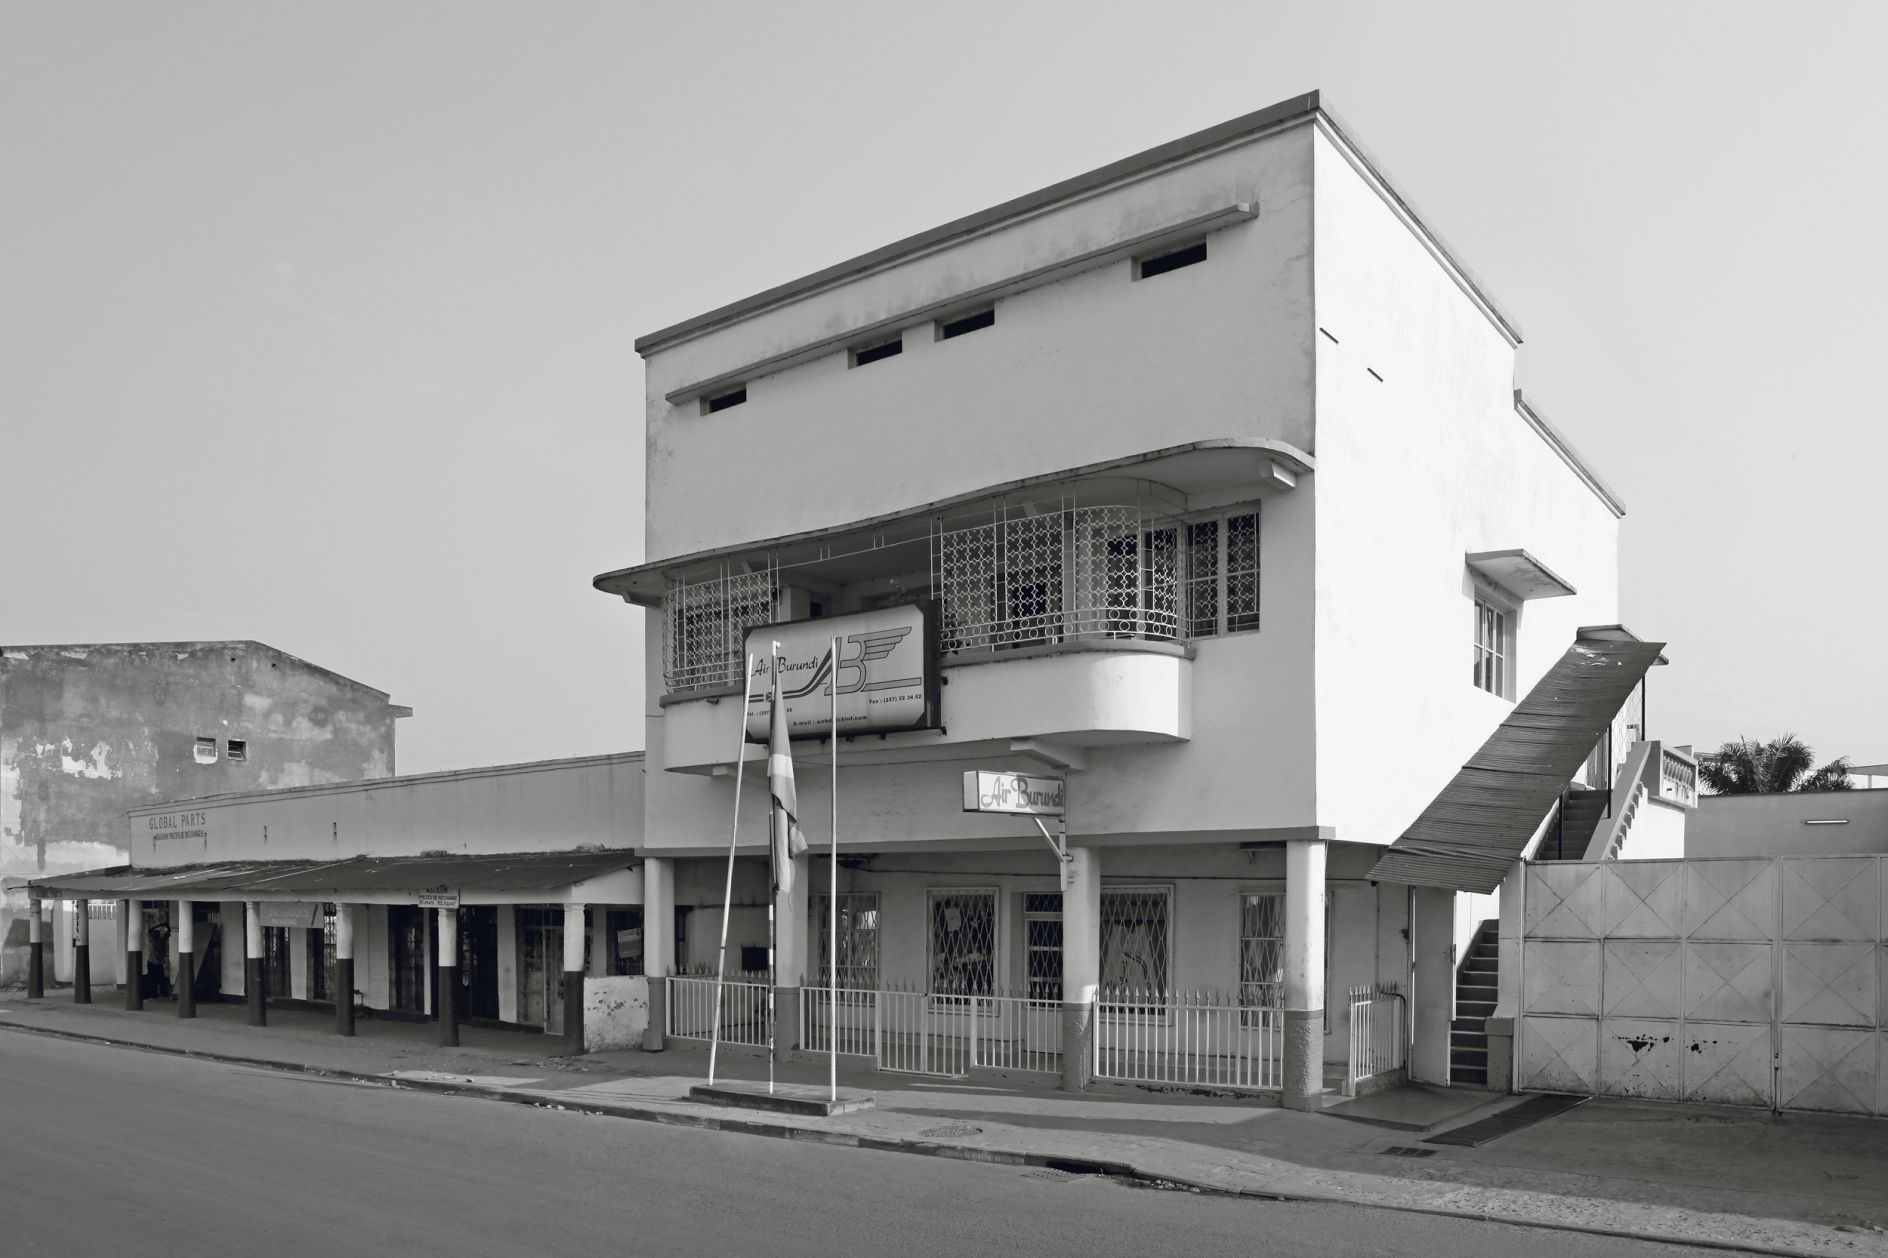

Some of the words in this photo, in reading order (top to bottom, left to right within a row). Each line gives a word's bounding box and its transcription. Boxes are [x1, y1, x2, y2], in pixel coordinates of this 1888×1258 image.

[751, 658, 770, 677] Air
[776, 655, 819, 674] Burundi
[793, 719, 812, 727] E-mail
[980, 776, 1011, 808] Air
[1011, 775, 1064, 808] Burundi
[149, 815, 177, 830] GLOBAL
[181, 812, 206, 827] PARTS
